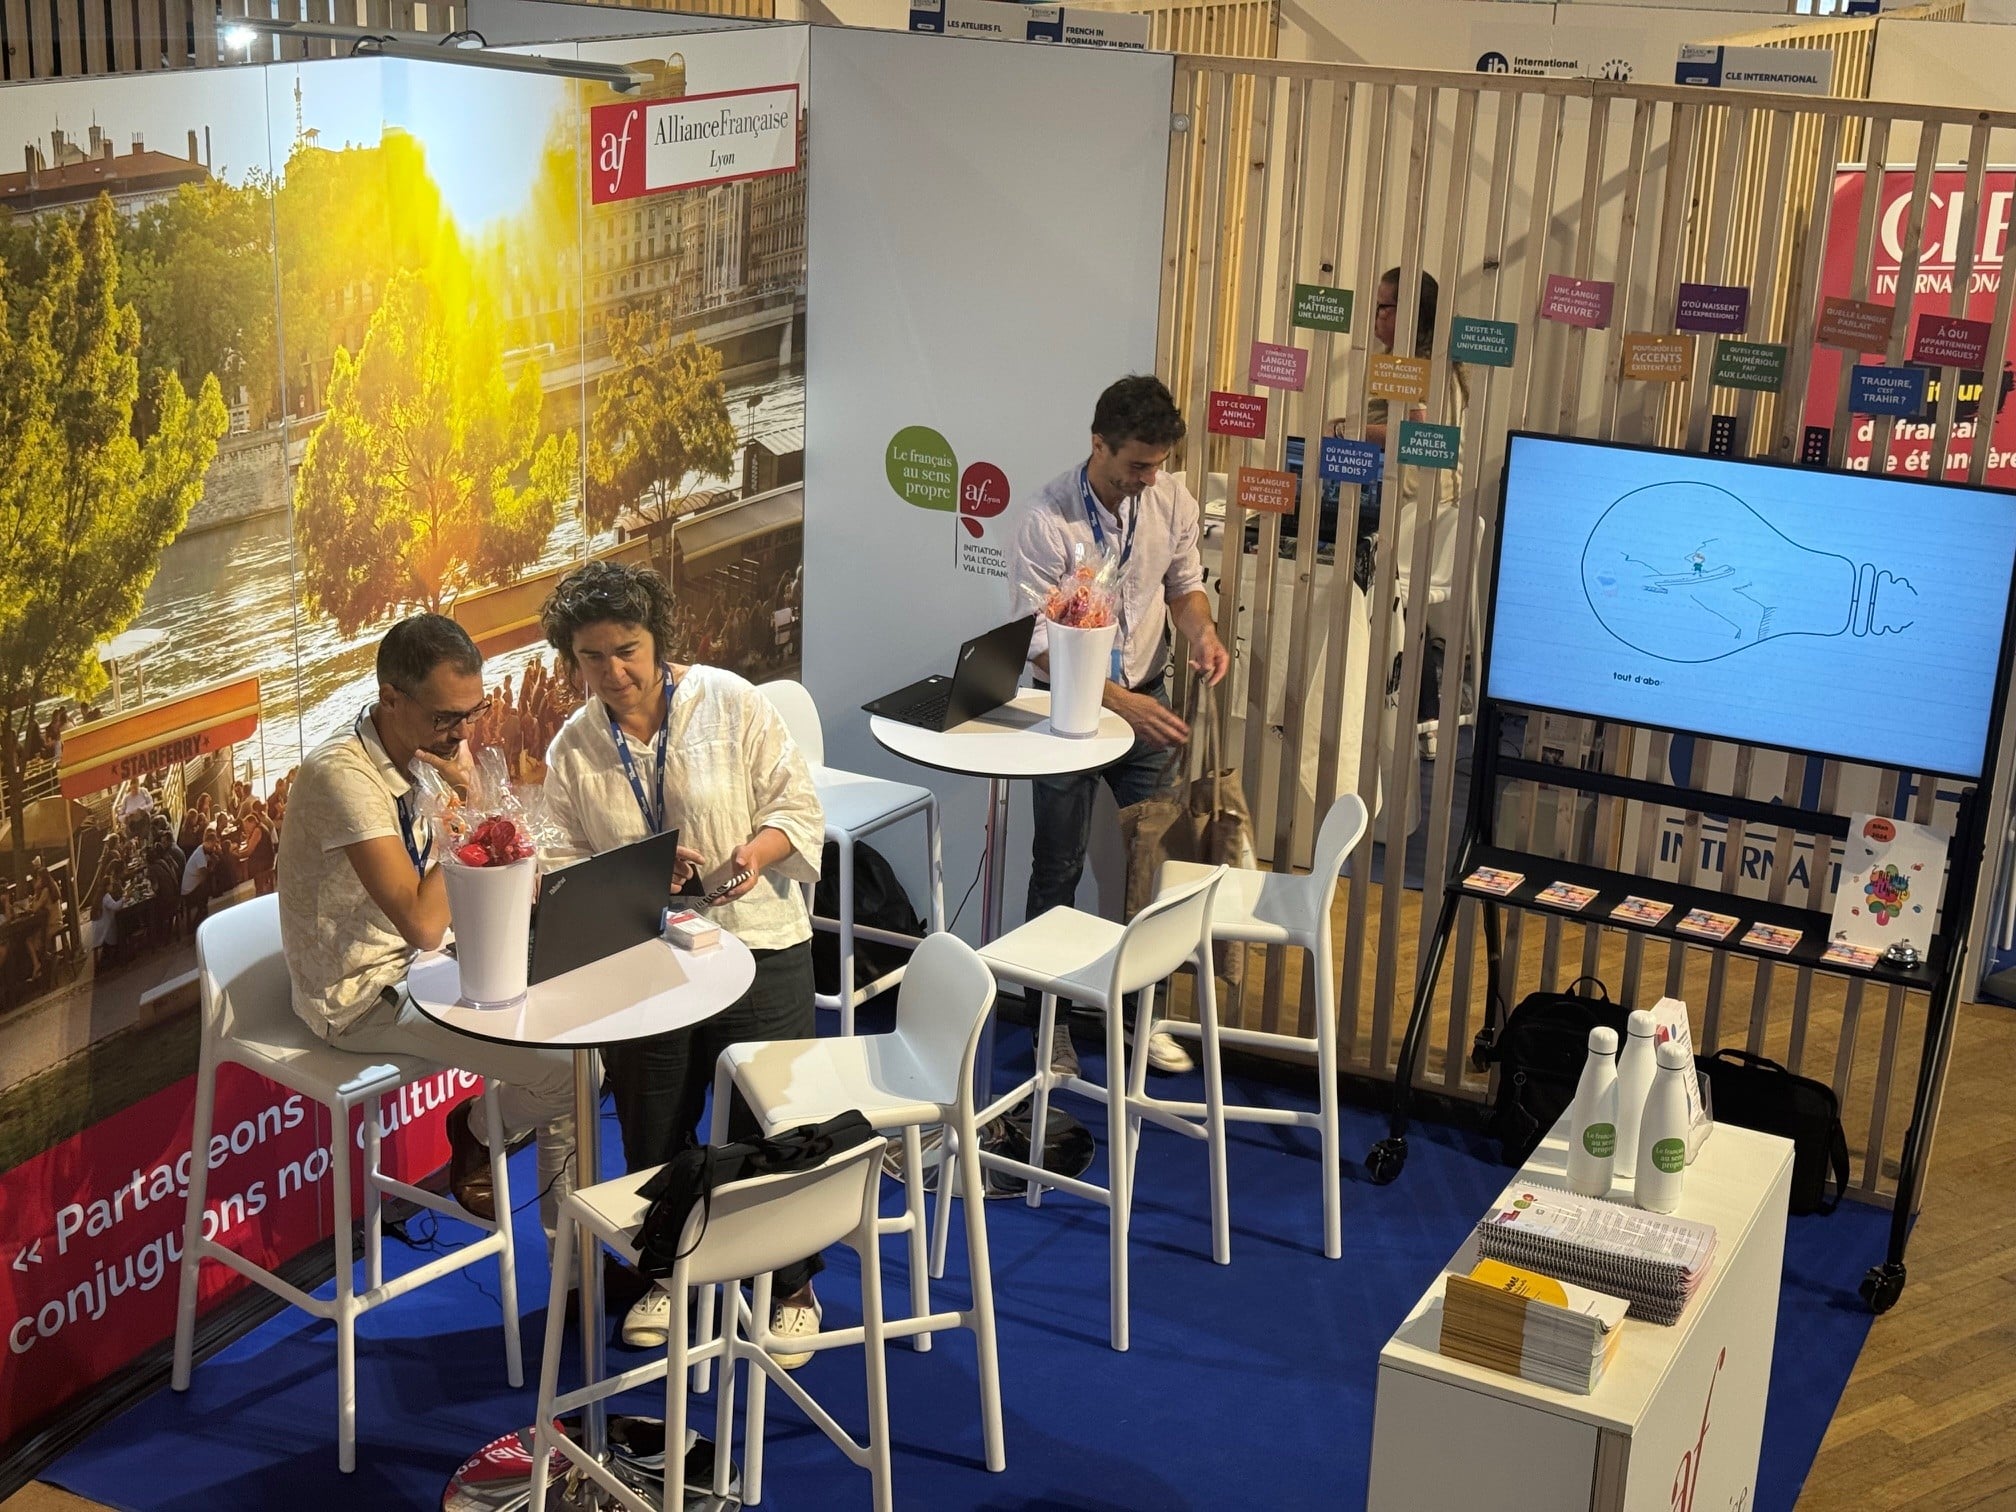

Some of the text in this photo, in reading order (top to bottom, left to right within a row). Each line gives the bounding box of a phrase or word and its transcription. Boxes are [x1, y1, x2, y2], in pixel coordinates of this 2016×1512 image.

[948, 20, 959, 28] LES
[961, 22, 992, 31] ATELIERS
[1066, 27, 1094, 36] FRENCH
[1066, 37, 1108, 47] NORMANDY
[1514, 56, 1578, 69] International
[1513, 67, 1545, 76] House
[1725, 72, 1818, 83] CLE INTERNATIONAL
[600, 110, 638, 194] af
[709, 150, 735, 172] Lyon
[1881, 190, 2014, 263] CLE
[1554, 286, 1600, 300] UNE LANGUE
[1308, 295, 1337, 304] PEUT-ON
[1299, 301, 1344, 315] MAÎTRISER
[1550, 302, 1592, 318] REVIVRE
[1682, 300, 1740, 311] D'OÙ NAISSENT
[1298, 311, 1311, 319] UNE
[1313, 313, 1340, 322] LANGUE
[1693, 311, 1734, 320] EXPRESSIONS
[1827, 308, 1856, 318] QUELLE
[1465, 325, 1488, 334] EXISTE
[1938, 327, 1968, 340] À QUI
[1461, 334, 1505, 345] UNE LANGUE
[1920, 337, 1982, 351] APPARTIENNENT
[1456, 342, 1503, 353] UNIVERSELLE
[1919, 346, 1979, 360] LES LANGUES ?
[1261, 355, 1296, 367] LANGUES
[1632, 353, 1682, 363] ACCENTS
[1722, 354, 1779, 367] LE NUMÉRIQUE
[1260, 364, 1296, 376] MEURENT
[1379, 362, 1394, 370] SON
[1632, 364, 1677, 372] EXISTENT-ILS
[1718, 370, 1735, 378] AUX
[1736, 372, 1772, 383] LANGUES
[1861, 376, 1912, 389] TRADUIRE,
[1372, 383, 1382, 391] ET
[1384, 384, 1394, 392] LE
[1396, 385, 1416, 394] TIEN
[1863, 393, 1899, 404] TRAHIR
[1216, 400, 1261, 411] EST-CE QU'UN
[1222, 410, 1254, 421] ANIMAL,
[1220, 418, 1229, 427] ÇA
[1230, 419, 1251, 428] PARLE
[1414, 431, 1443, 439] PEUT-ON
[1858, 420, 1874, 442] d
[1410, 438, 1447, 449] PARLER
[893, 446, 952, 468] Le français
[1337, 448, 1373, 458] PARLE-T-ON
[1401, 447, 1423, 456] SANS
[1425, 449, 1448, 459] MOTS
[1339, 456, 1373, 467] LANGUE
[1328, 464, 1339, 472] DE
[1342, 466, 1361, 476] BOIS
[904, 468, 950, 484] au sens
[1243, 476, 1290, 488] LES LANGUES
[906, 482, 950, 500] propre
[965, 479, 992, 510] af
[1250, 486, 1282, 495] ONT-ELLES
[984, 494, 1001, 504] Lyon
[1242, 492, 1256, 501] UN
[1258, 494, 1282, 505] SEXE
[964, 544, 1002, 556] INITIATION
[964, 554, 976, 564] VIA
[963, 564, 976, 573] VIA
[977, 565, 986, 574] LE
[1613, 672, 1632, 682] tout
[120, 735, 201, 778] STARFERRY
[56, 1094, 304, 1256] Partageons
[8, 1068, 484, 1354] conjuguons no ulture
